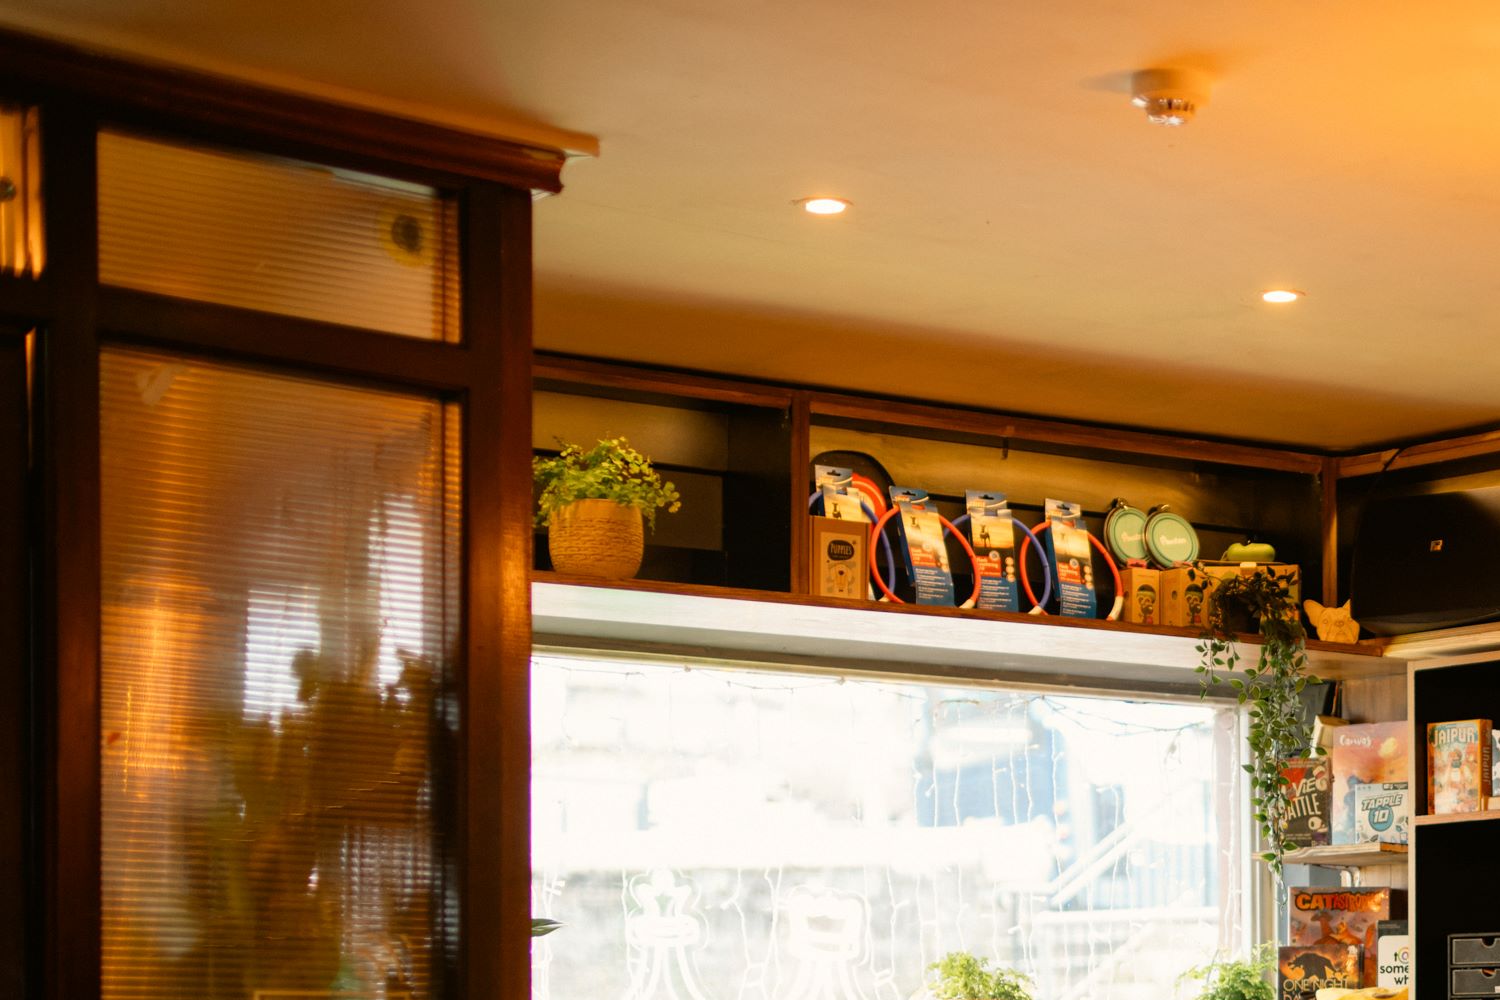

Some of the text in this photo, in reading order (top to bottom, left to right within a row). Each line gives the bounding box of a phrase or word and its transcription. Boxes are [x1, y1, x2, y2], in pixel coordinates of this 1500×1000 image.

[1433, 727, 1474, 747] JAIPUR
[1362, 794, 1403, 811] TAPPLE
[1374, 809, 1389, 824] 10
[1283, 979, 1348, 991] ONE NIGHT
